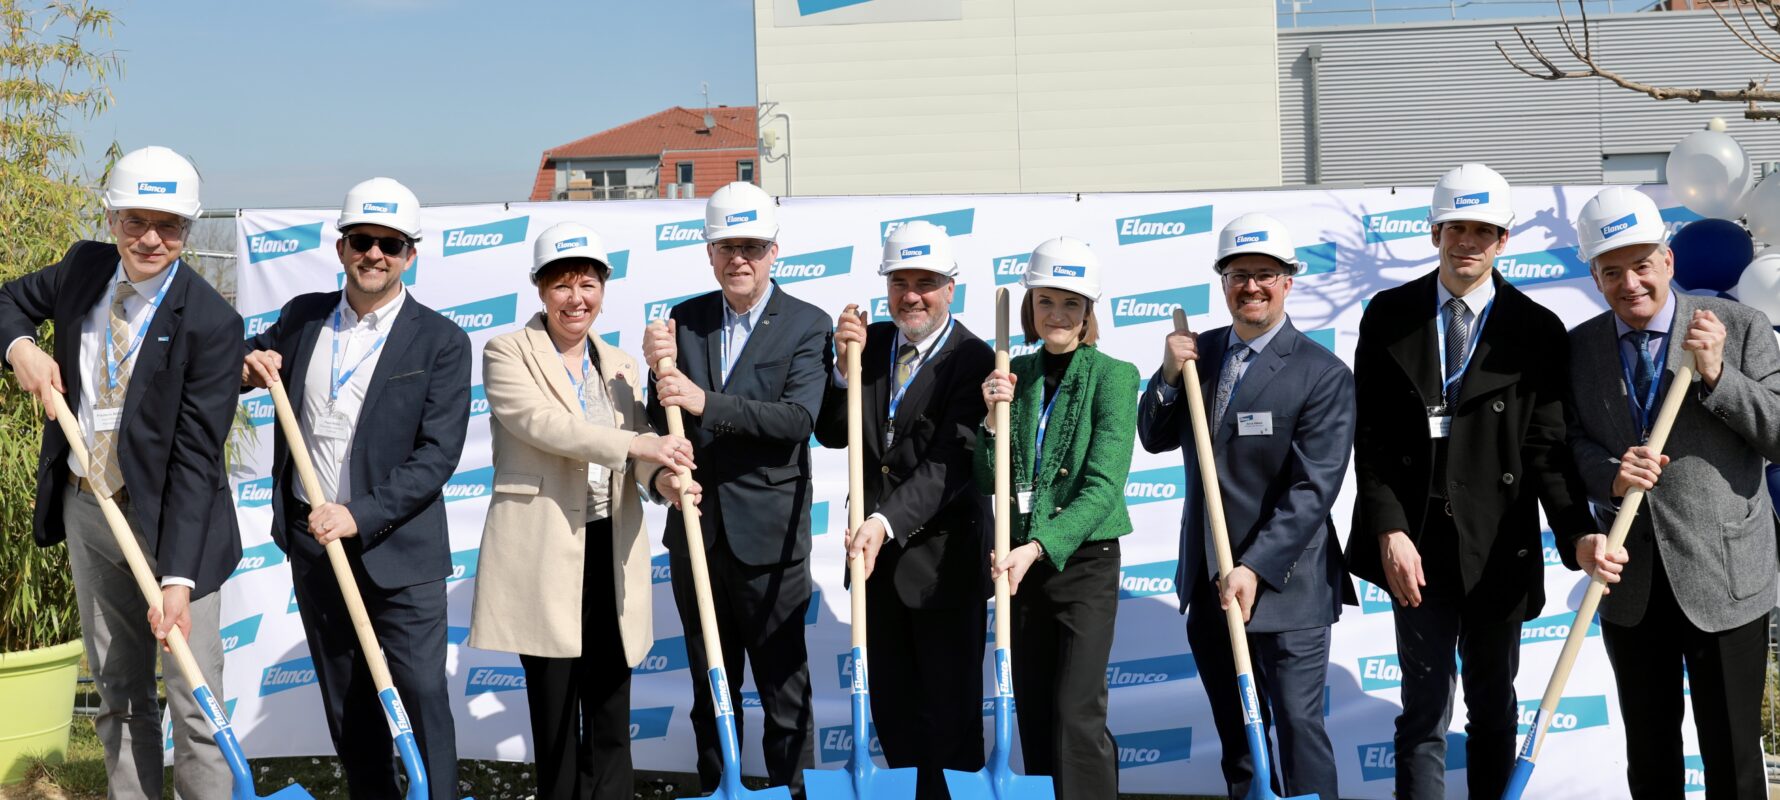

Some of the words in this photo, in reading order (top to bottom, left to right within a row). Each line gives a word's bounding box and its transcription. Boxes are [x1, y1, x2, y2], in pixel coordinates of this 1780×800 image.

[139, 183, 166, 193] Elanco
[363, 203, 388, 213] Elanco
[1455, 197, 1480, 205] Elanco
[727, 214, 749, 223] Elanco
[1367, 216, 1431, 233] Elanco
[659, 225, 703, 241] Elanc
[1121, 219, 1185, 235] Elanco
[1603, 222, 1628, 235] Elanco
[250, 236, 299, 254] Elanco
[445, 231, 503, 247] Elanco
[557, 242, 579, 250] Elanco
[1236, 235, 1259, 243] Elanco
[997, 259, 1026, 275] Ela
[1053, 266, 1077, 276] Elanco
[1497, 259, 1565, 279] Elanco
[247, 400, 275, 418] Elan
[241, 483, 272, 500] Elan
[237, 556, 265, 570] nco
[1119, 571, 1172, 592] lanco
[1521, 624, 1571, 640] anco
[263, 668, 315, 687] Elanco
[854, 659, 864, 689] Elanco
[999, 660, 1009, 693] Elanco
[717, 680, 730, 711] Elanco
[1246, 686, 1261, 720] Elanco
[206, 697, 229, 729] Elanco
[391, 699, 410, 730] Elanco
[1364, 747, 1395, 768] Ela
